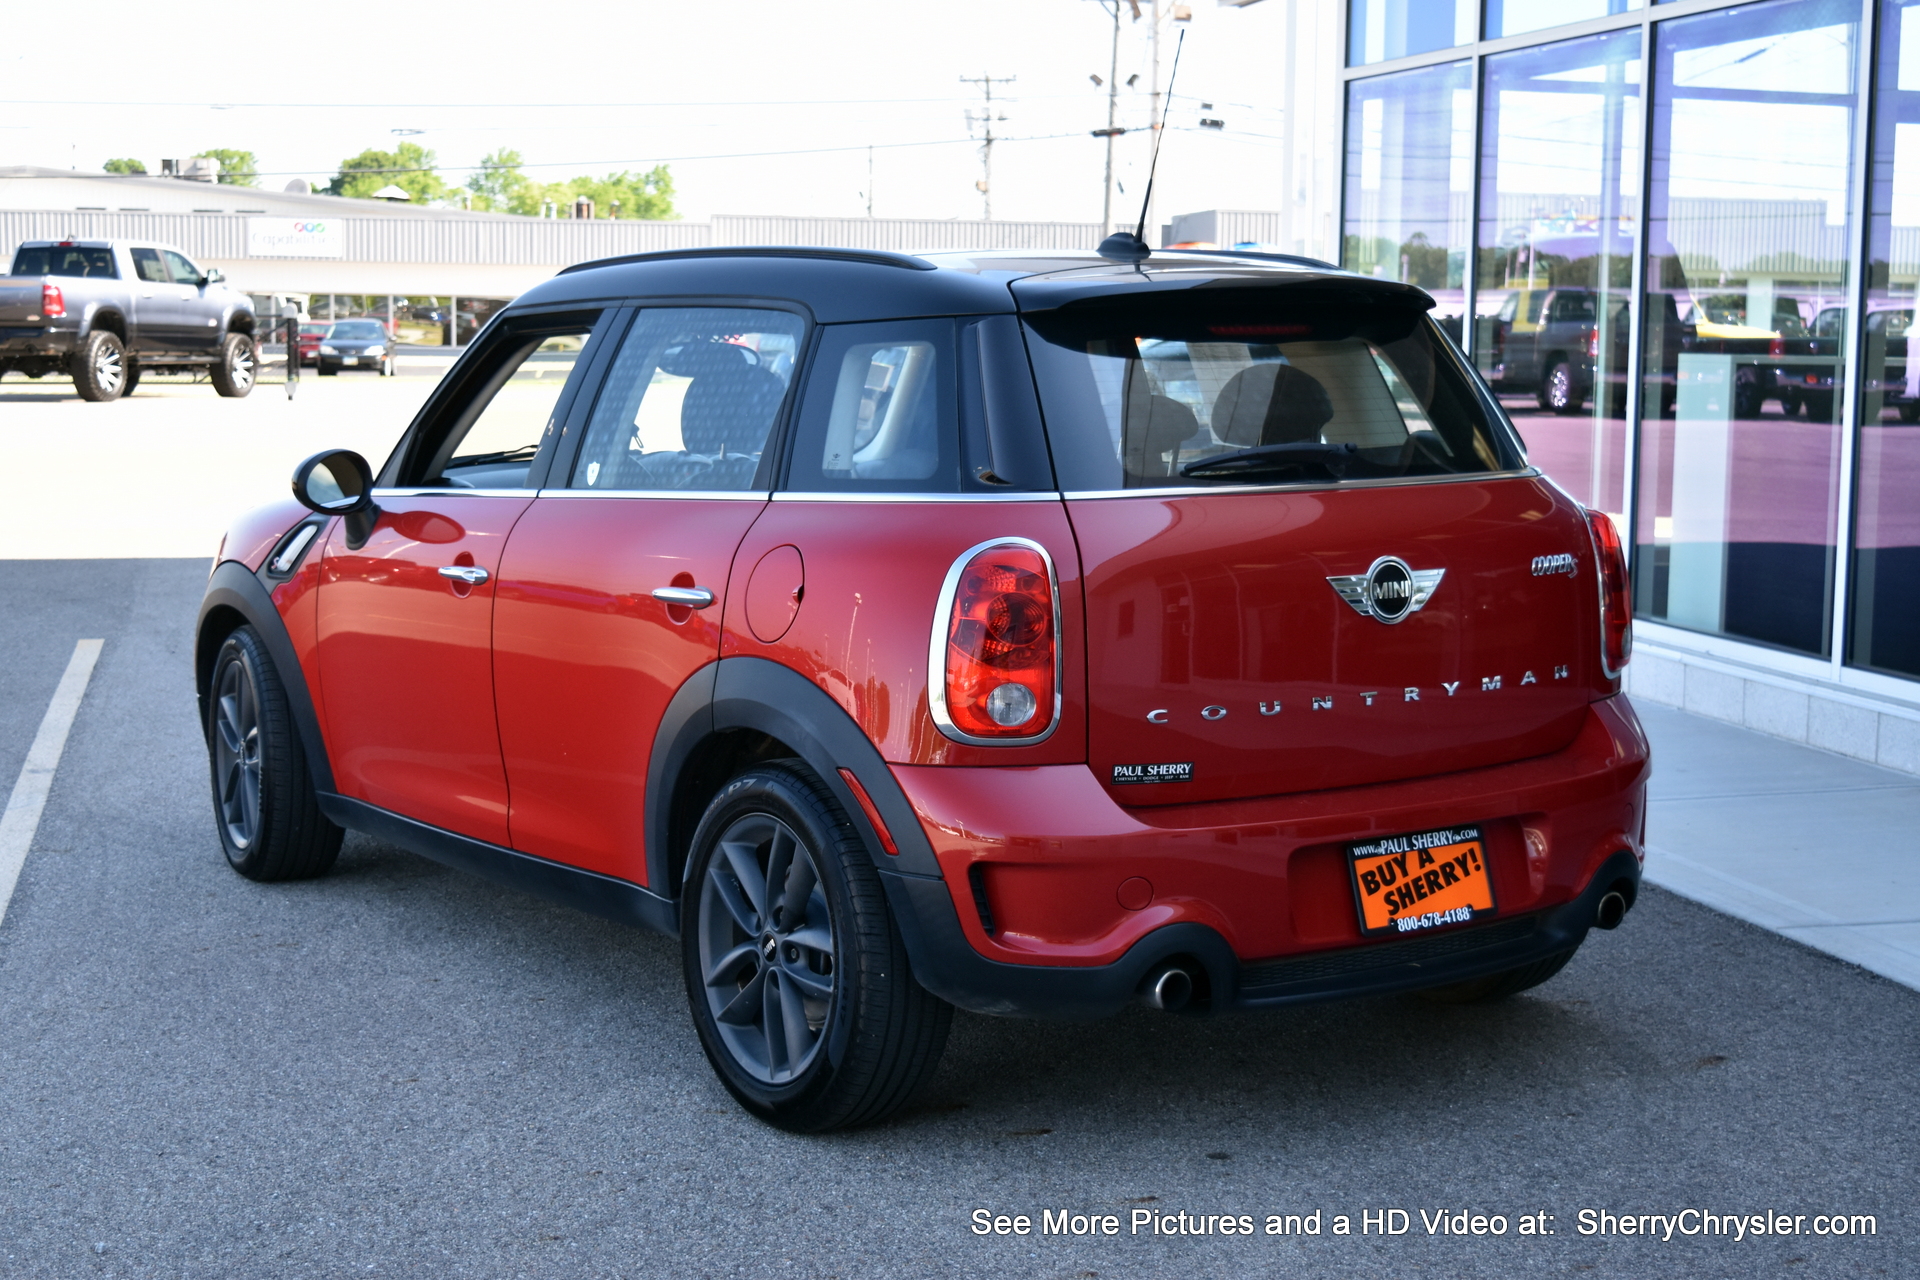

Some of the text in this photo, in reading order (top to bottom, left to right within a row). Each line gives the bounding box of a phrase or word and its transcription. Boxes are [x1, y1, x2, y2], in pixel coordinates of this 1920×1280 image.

[1374, 580, 1411, 600] MINI
[1147, 665, 1568, 724] COUNTRYMAN
[1114, 764, 1191, 776] PAUL SHERRY
[1411, 830, 1454, 850] SHERRY
[1360, 849, 1435, 896] BUY A
[1383, 847, 1482, 916] SHERRY!
[1397, 907, 1470, 932] 800-678-4188
